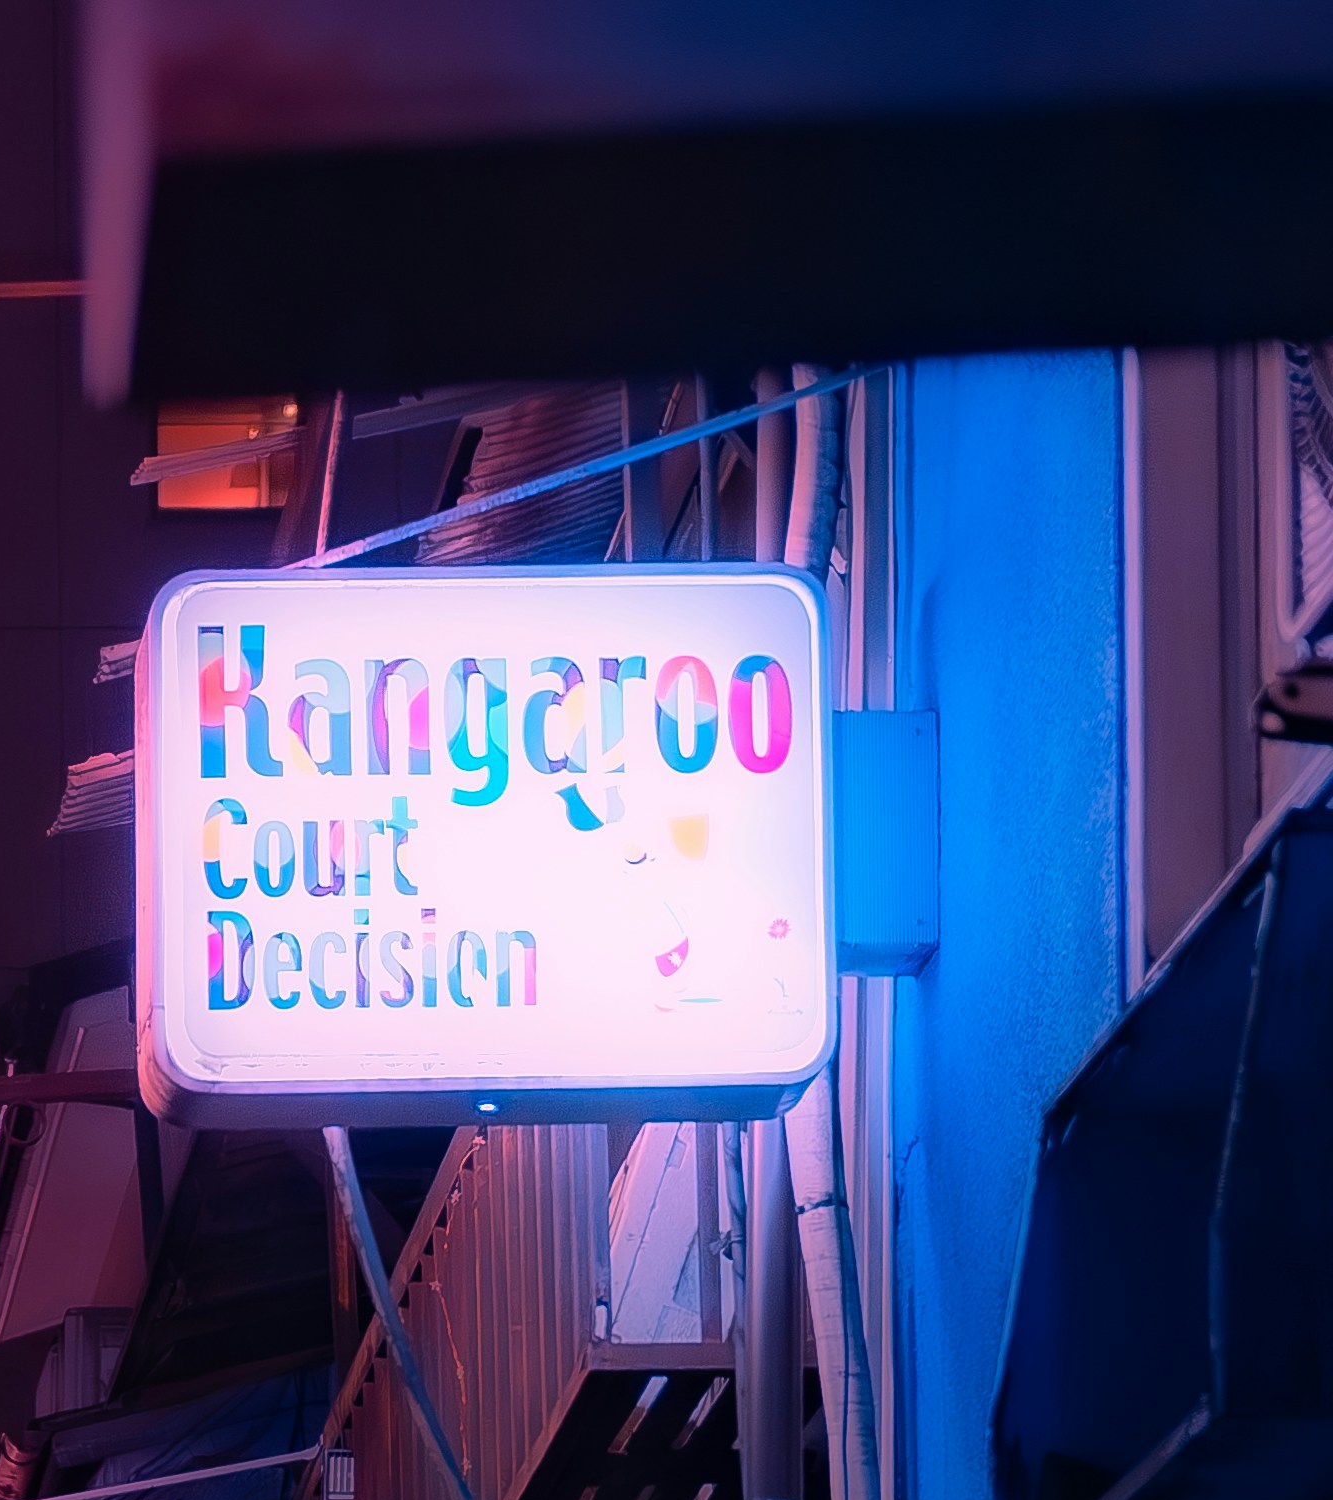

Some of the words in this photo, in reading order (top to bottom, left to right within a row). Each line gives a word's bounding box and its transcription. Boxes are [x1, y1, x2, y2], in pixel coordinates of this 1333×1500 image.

[197, 624, 793, 806] Kangaroo
[202, 796, 419, 900] Court
[206, 908, 538, 1011] Decision
